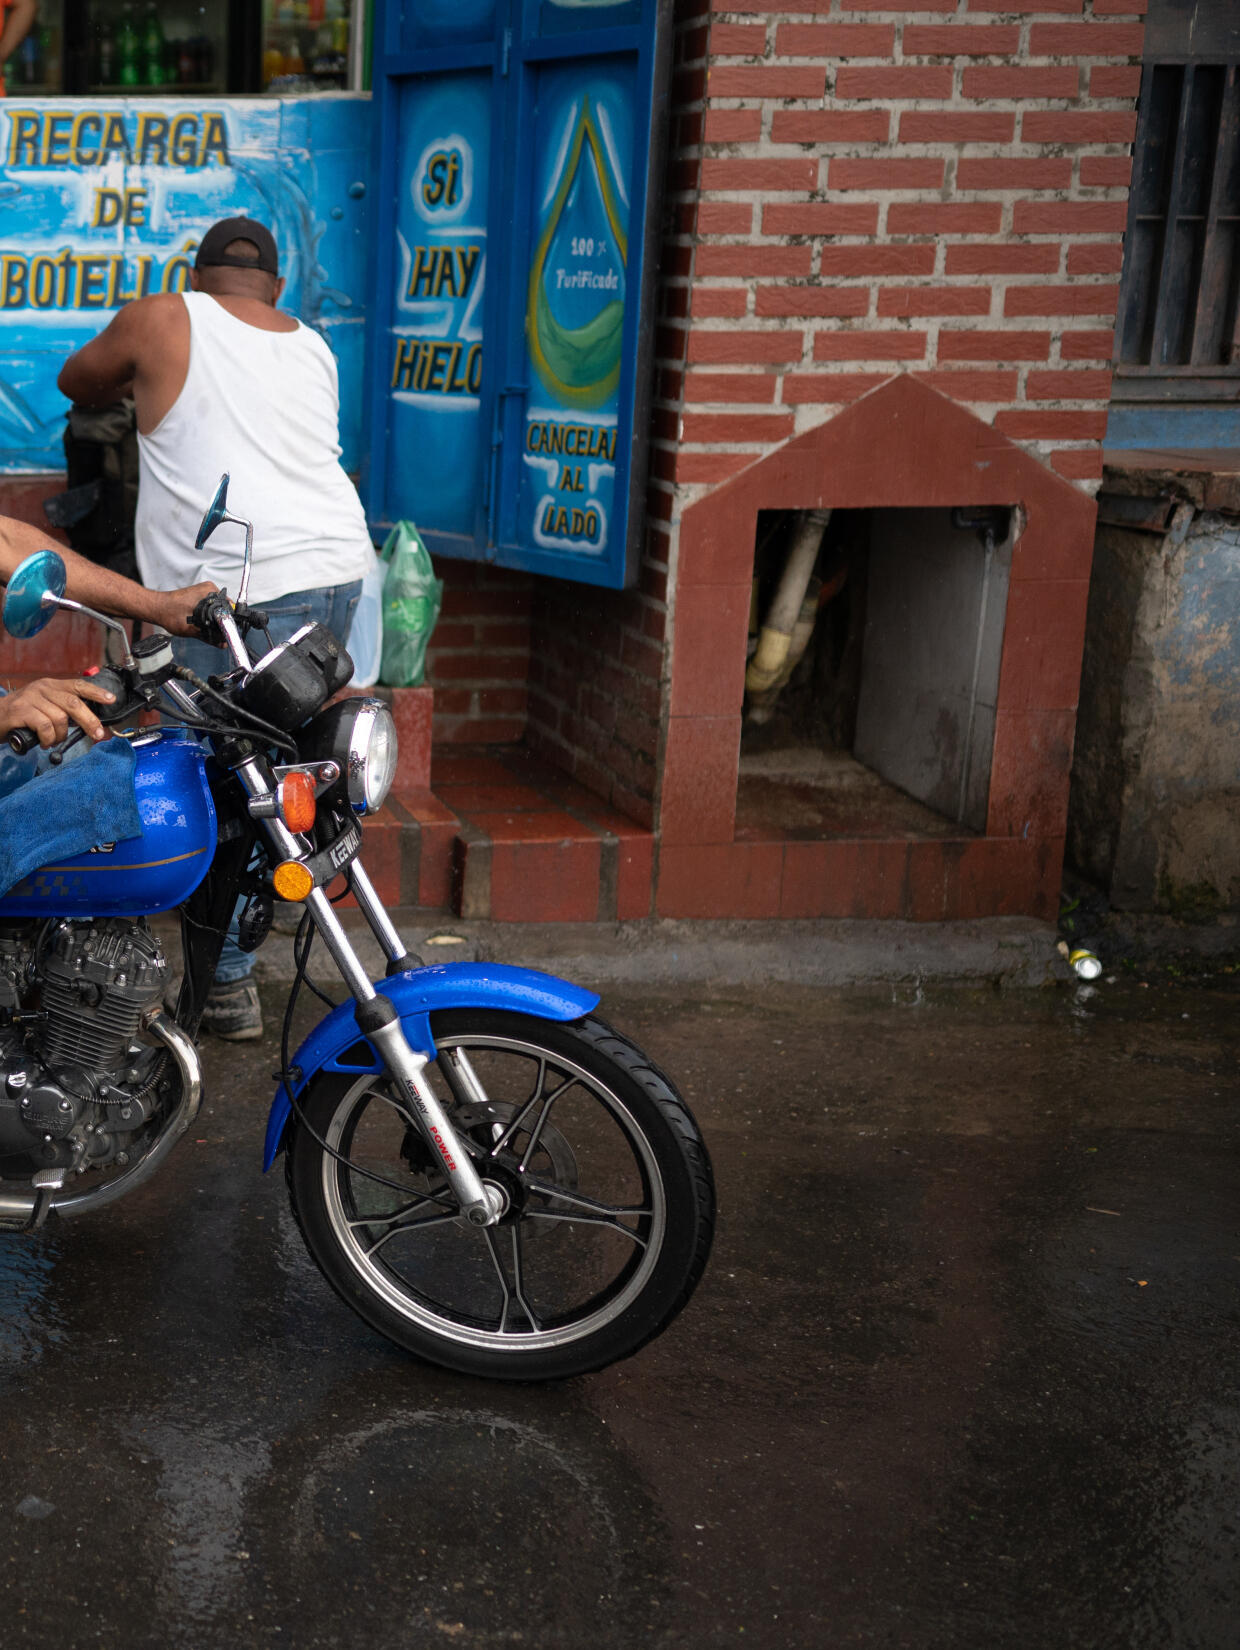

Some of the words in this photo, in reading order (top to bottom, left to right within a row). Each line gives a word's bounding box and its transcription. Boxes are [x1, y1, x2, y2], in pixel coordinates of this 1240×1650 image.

[7, 110, 232, 167] RECARGA
[91, 187, 148, 228] DE
[571, 236, 594, 256] 100
[408, 246, 480, 298] HAY
[559, 465, 585, 492] AL
[544, 505, 597, 538] LADO
[430, 1126, 457, 1172] POWER
